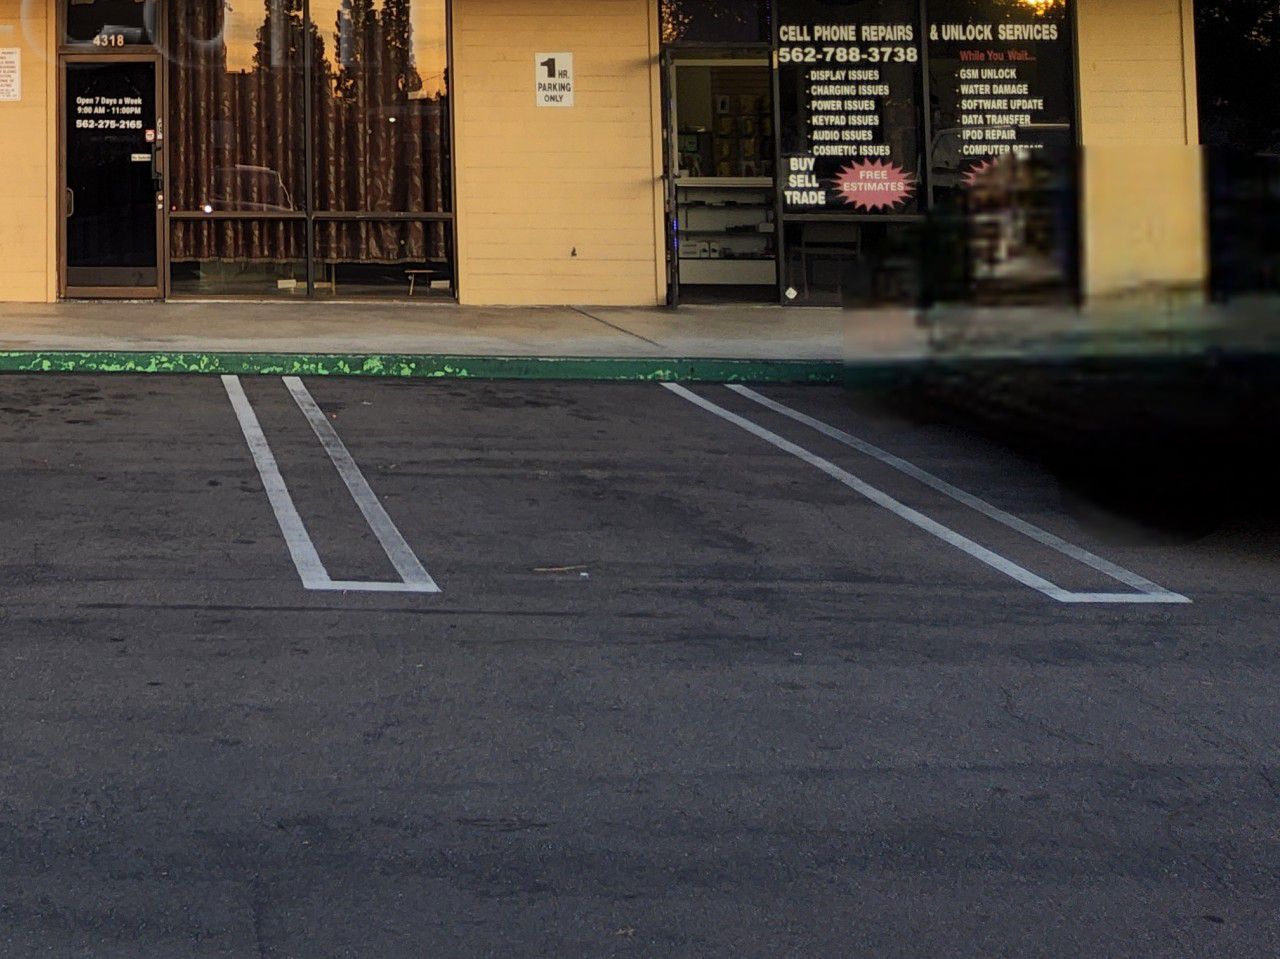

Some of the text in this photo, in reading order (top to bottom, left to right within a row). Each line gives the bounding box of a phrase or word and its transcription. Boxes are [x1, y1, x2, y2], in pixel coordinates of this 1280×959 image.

[779, 24, 914, 41] CELL PHONE REPAIRS
[929, 24, 1058, 41] & UNLOCK SERVICES
[92, 34, 125, 47] 4318
[778, 47, 919, 63] 562-788-3738
[959, 50, 985, 61] While
[987, 50, 1004, 61] You
[540, 58, 556, 78] 1
[960, 68, 1017, 79] GSM UNLOCK
[810, 70, 879, 81] DISPLAY ISSUES
[537, 82, 572, 92] PARKING
[810, 85, 889, 96] CHARGING ISSUES
[960, 84, 1029, 95] WATER DAMAGE
[76, 96, 94, 105] Open
[101, 96, 117, 105] Days
[123, 96, 142, 105] Week
[543, 94, 564, 103] ONLY
[77, 106, 93, 114] 9:00
[93, 106, 106, 114] AM
[811, 100, 875, 111] POWER ISSUES
[961, 99, 1044, 110] SOFTWARE UPDATE
[75, 119, 143, 129] 562-275-2165
[812, 115, 879, 126] KEYPAD ISSUES
[962, 114, 1031, 125] DATA TRANSFER
[812, 130, 873, 141] AUDIO ISSUES
[962, 129, 1017, 140] IPOD REPAIR
[813, 145, 891, 156] COSMETIC ISSUES
[963, 144, 1010, 155] COMPUTER
[789, 157, 816, 171] BUY
[859, 170, 888, 179] FREE
[788, 174, 819, 188] SELL
[843, 182, 905, 192] ESTIMATES
[783, 191, 826, 205] TRADE
